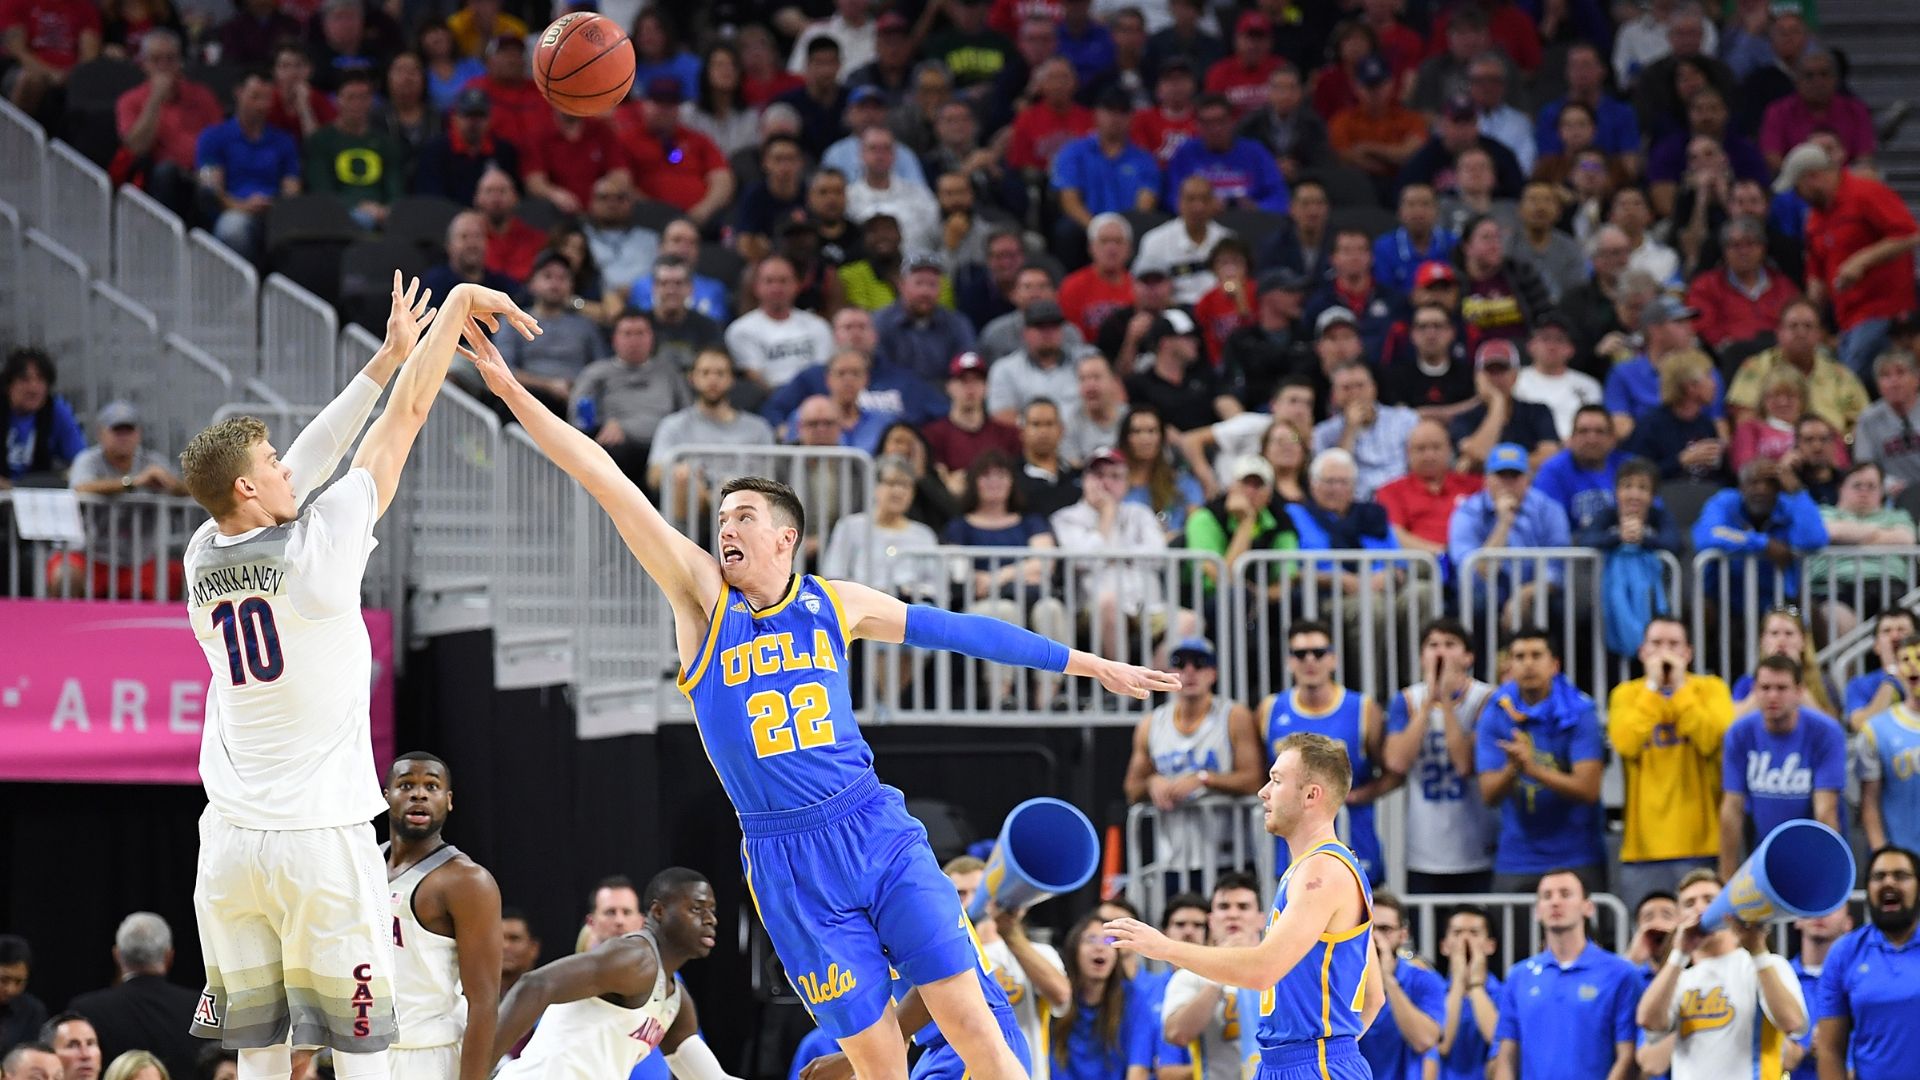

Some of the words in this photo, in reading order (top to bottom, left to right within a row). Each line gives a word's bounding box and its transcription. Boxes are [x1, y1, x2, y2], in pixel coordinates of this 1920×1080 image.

[335, 148, 382, 186] O
[193, 565, 284, 608] MARKKANEN
[211, 596, 284, 687] 10
[720, 629, 839, 687] UCLA
[51, 678, 204, 734] ARE
[746, 681, 836, 759] 22
[1746, 750, 1813, 794] Ucla
[351, 963, 373, 1038] CATS
[797, 962, 857, 1005] Ucla
